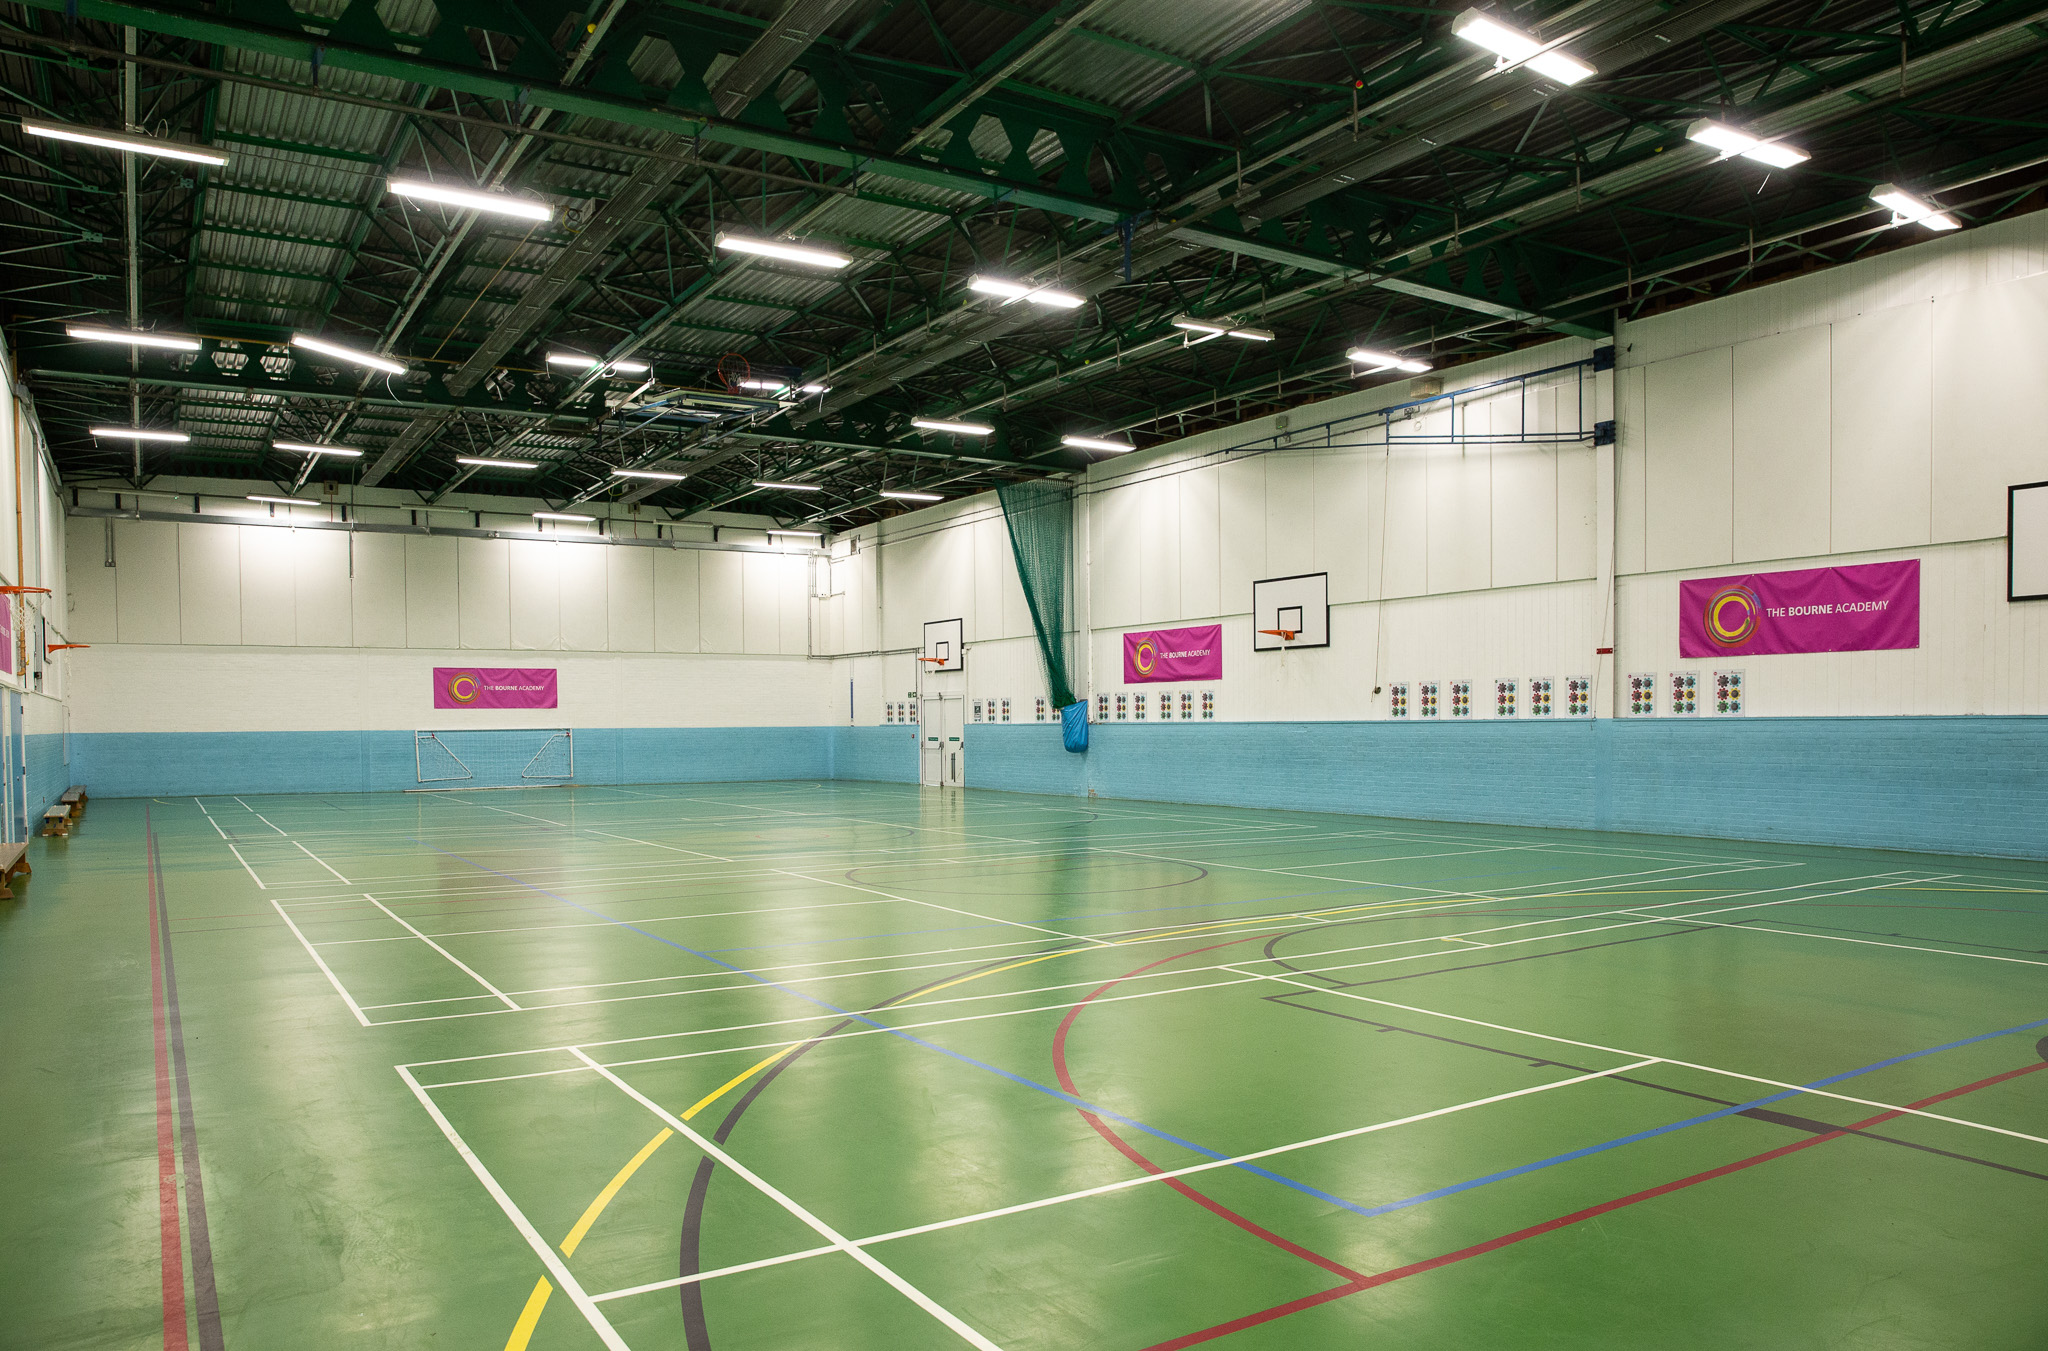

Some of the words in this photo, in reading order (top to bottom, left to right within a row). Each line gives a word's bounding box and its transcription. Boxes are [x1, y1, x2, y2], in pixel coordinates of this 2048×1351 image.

[1766, 608, 1785, 617] THE
[1788, 604, 1833, 617] BOURNE
[1835, 600, 1889, 613] ACADEMY
[1188, 649, 1210, 657] ACADEMY
